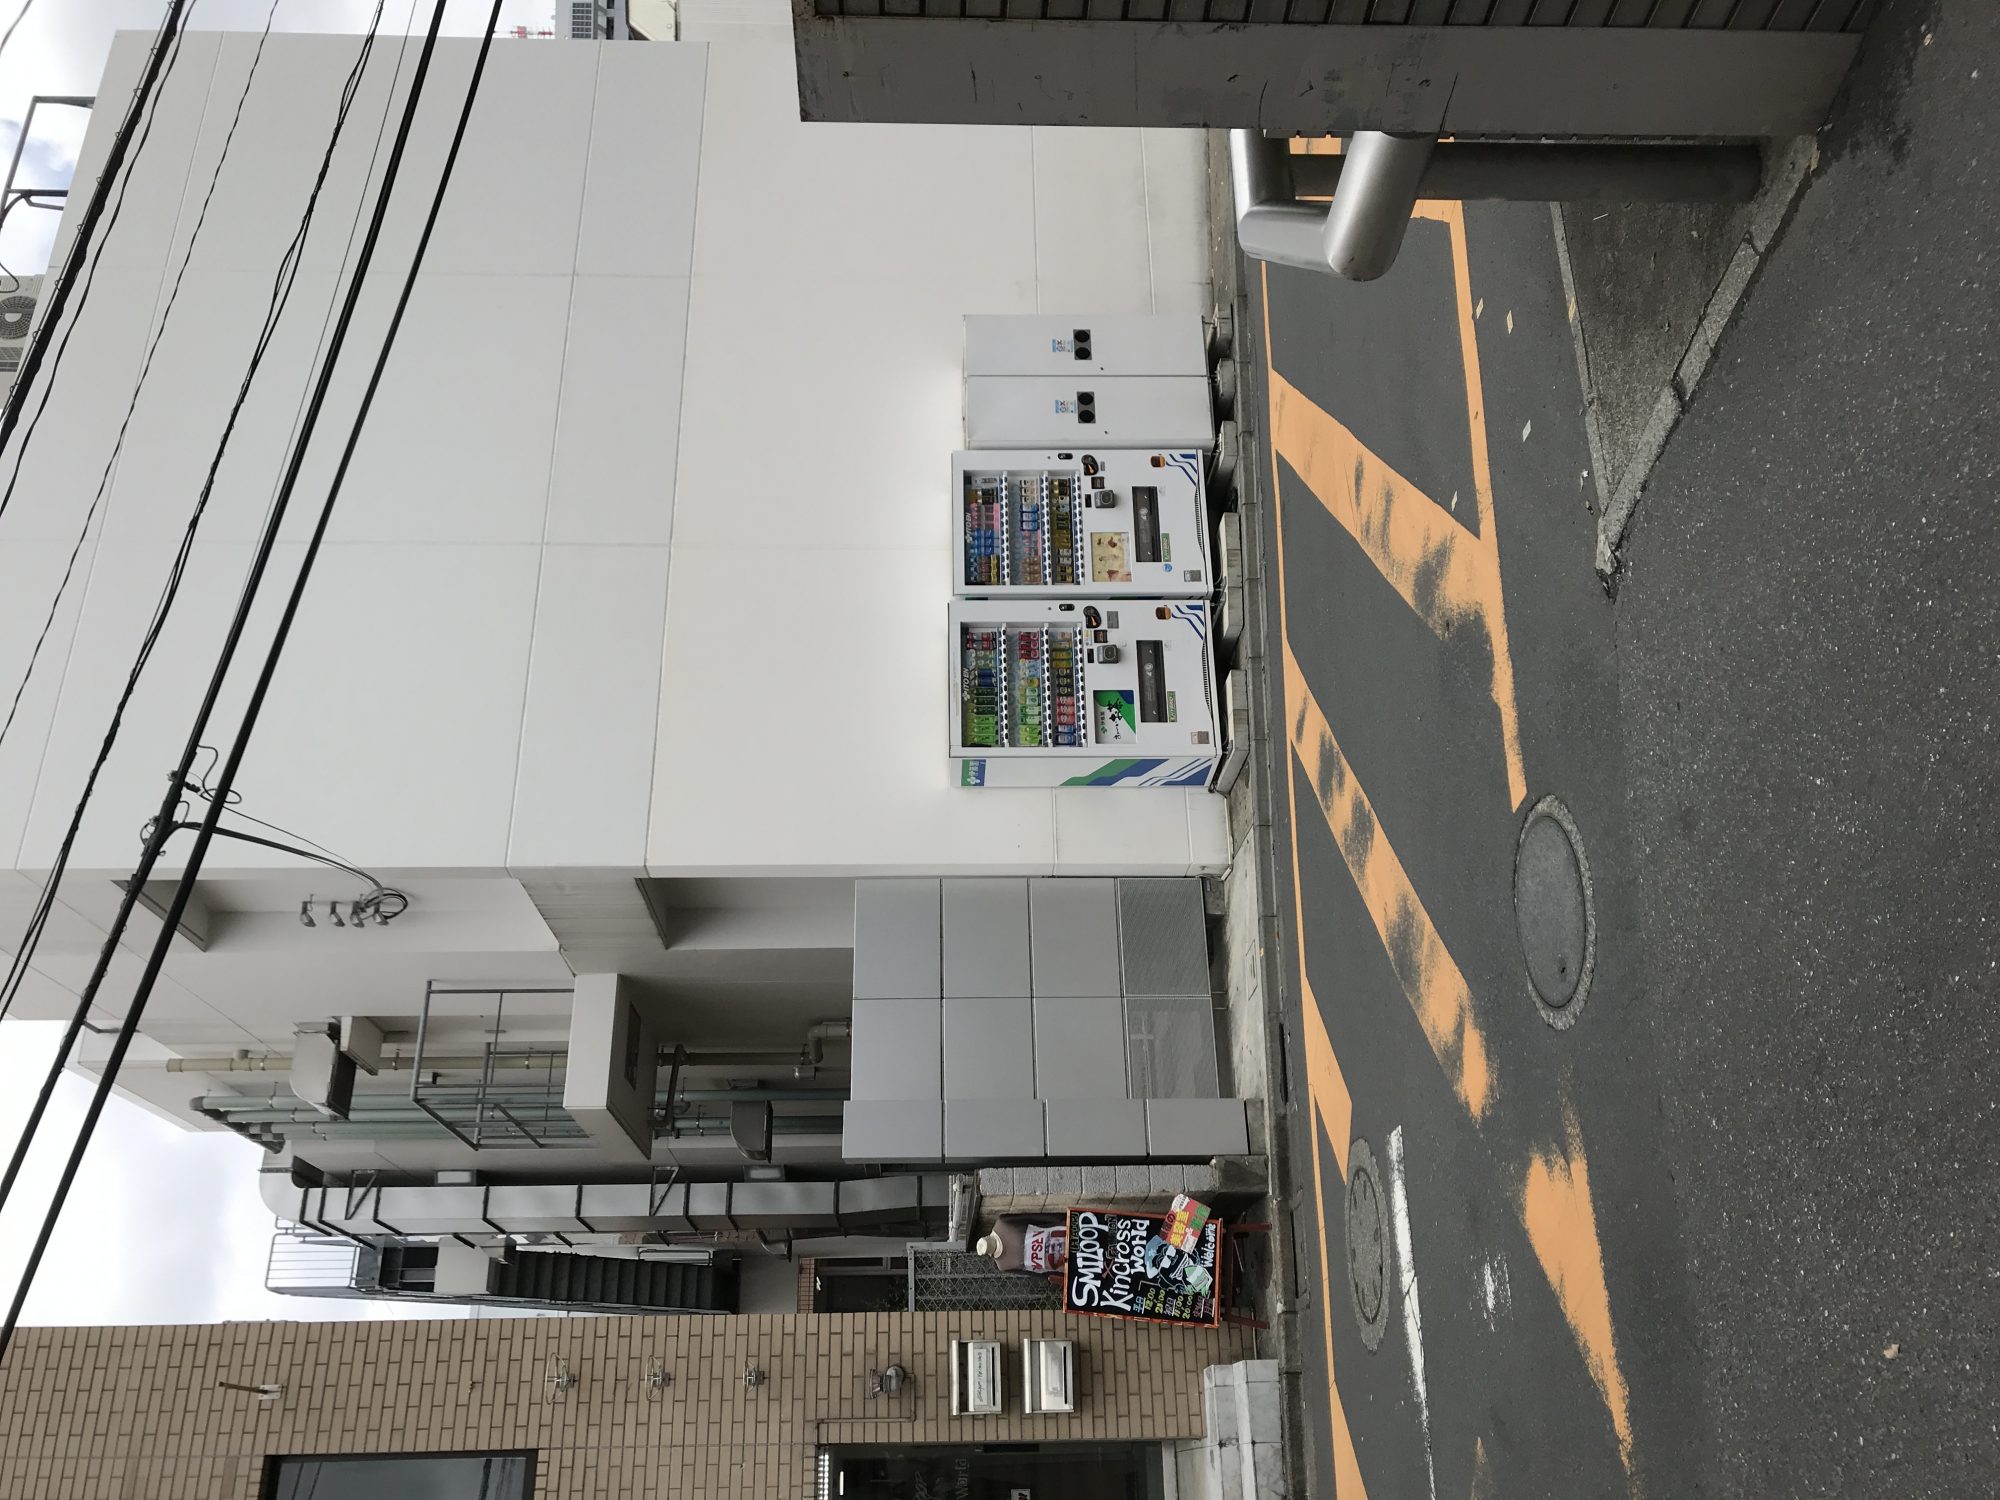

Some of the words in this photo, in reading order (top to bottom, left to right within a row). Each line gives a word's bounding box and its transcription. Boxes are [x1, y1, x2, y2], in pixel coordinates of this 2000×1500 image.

[1170, 1209, 1189, 1247] 美容室
[1200, 1224, 1216, 1268] Welcome
[1072, 1212, 1108, 1306] SMILOOP
